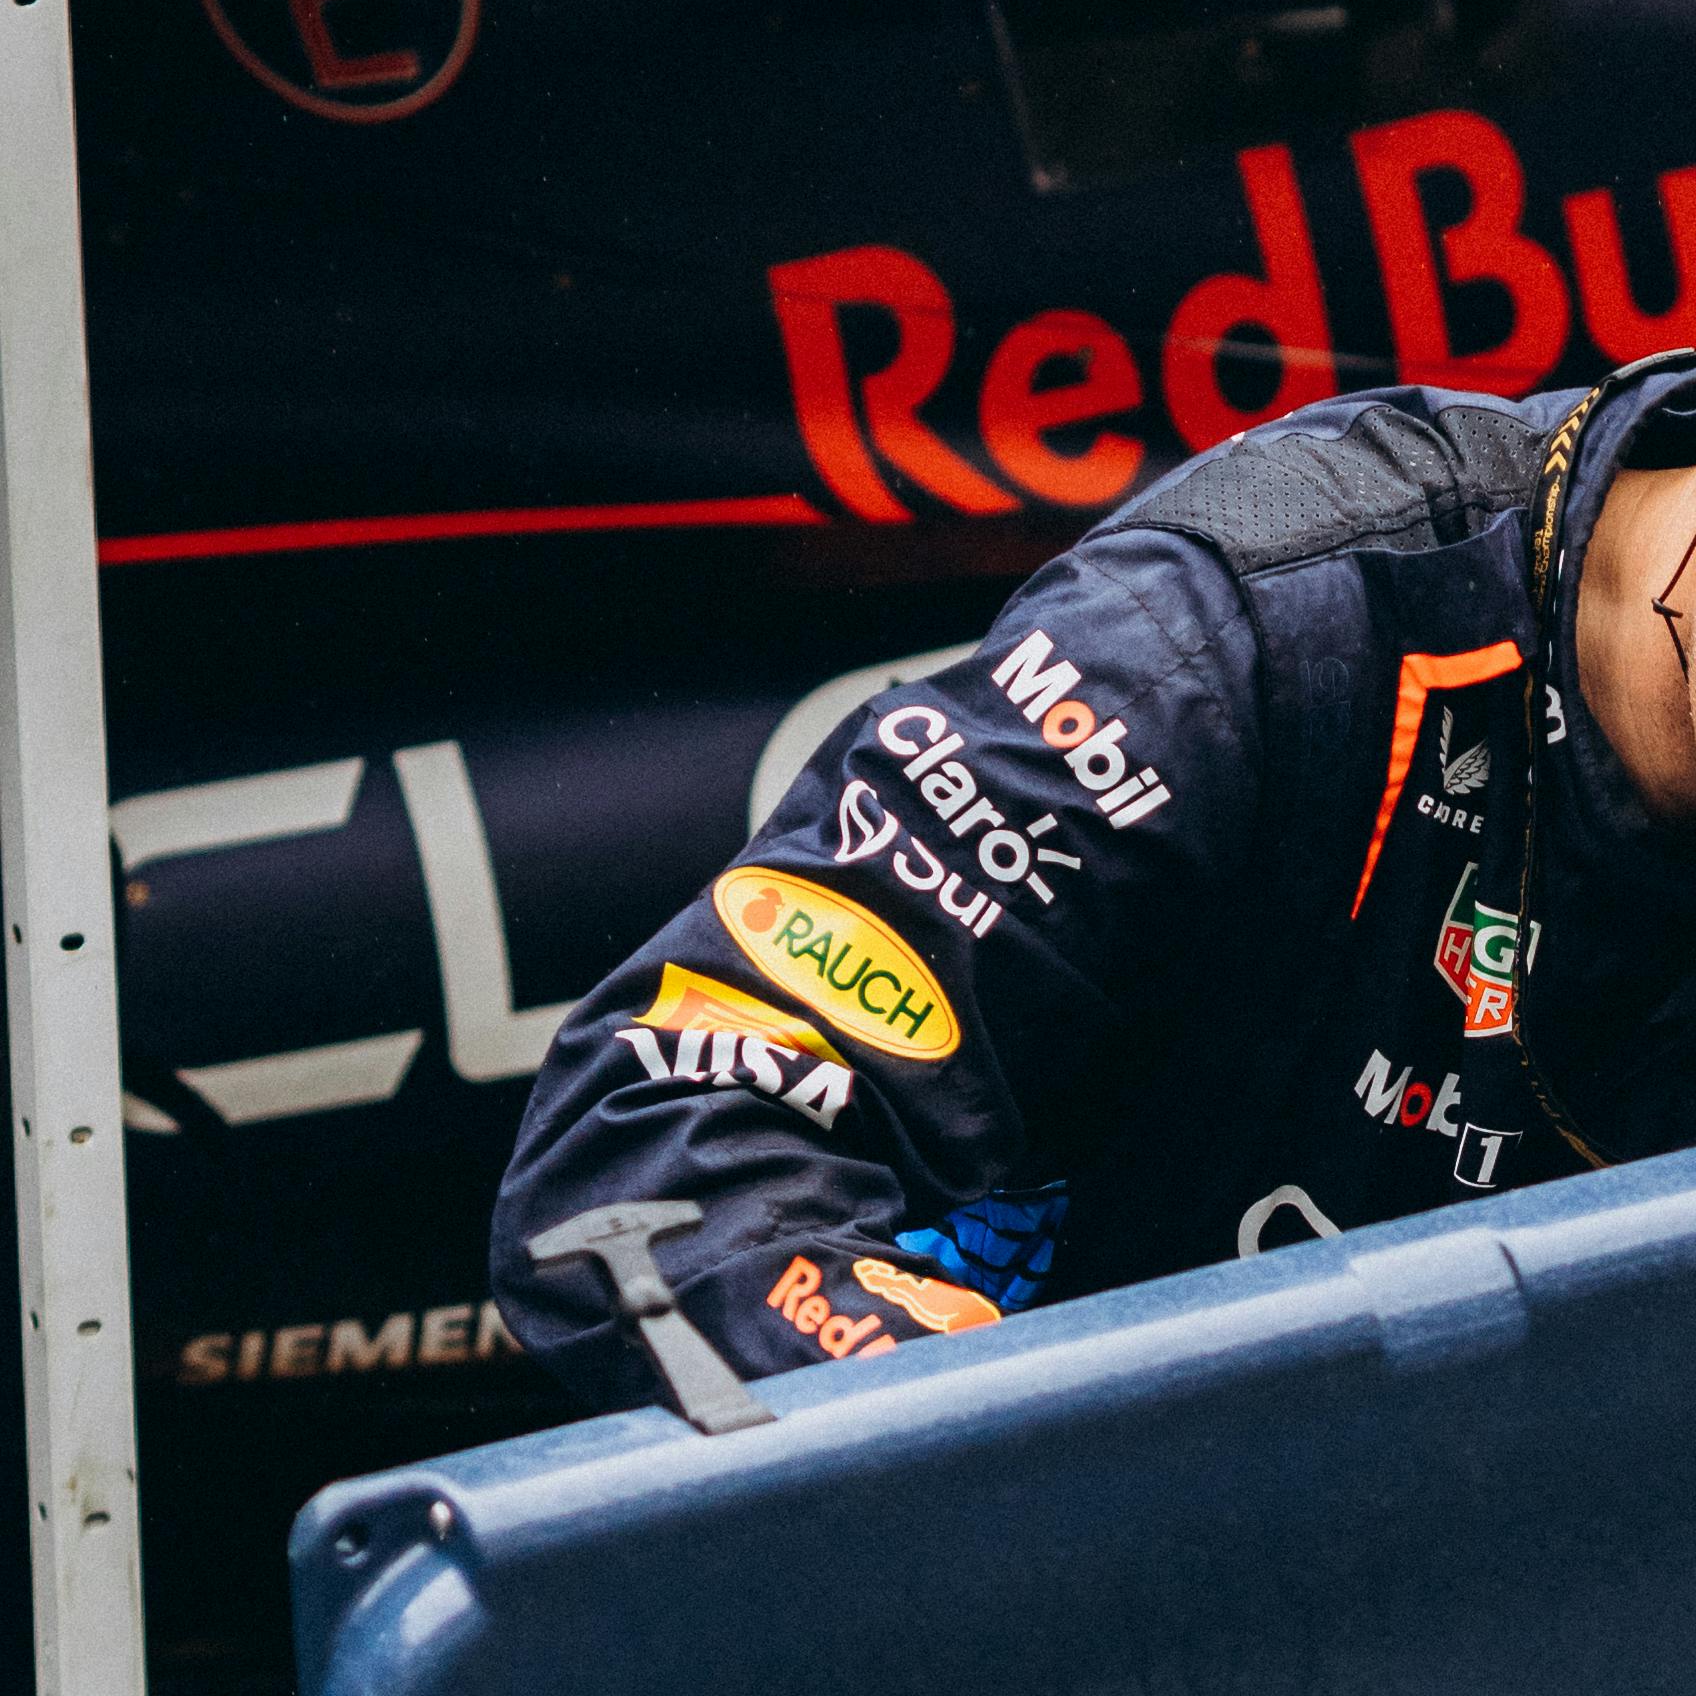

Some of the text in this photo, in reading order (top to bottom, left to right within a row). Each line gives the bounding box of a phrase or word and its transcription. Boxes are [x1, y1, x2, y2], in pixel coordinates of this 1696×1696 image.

[768, 143, 1340, 524] Red
[878, 706, 1031, 883] Claro
[991, 629, 1172, 831] Mobil
[773, 908, 934, 1042] RAUCH
[614, 1027, 853, 1132] VISA
[1476, 1135, 1503, 1183] 1
[766, 1255, 882, 1360] Red
